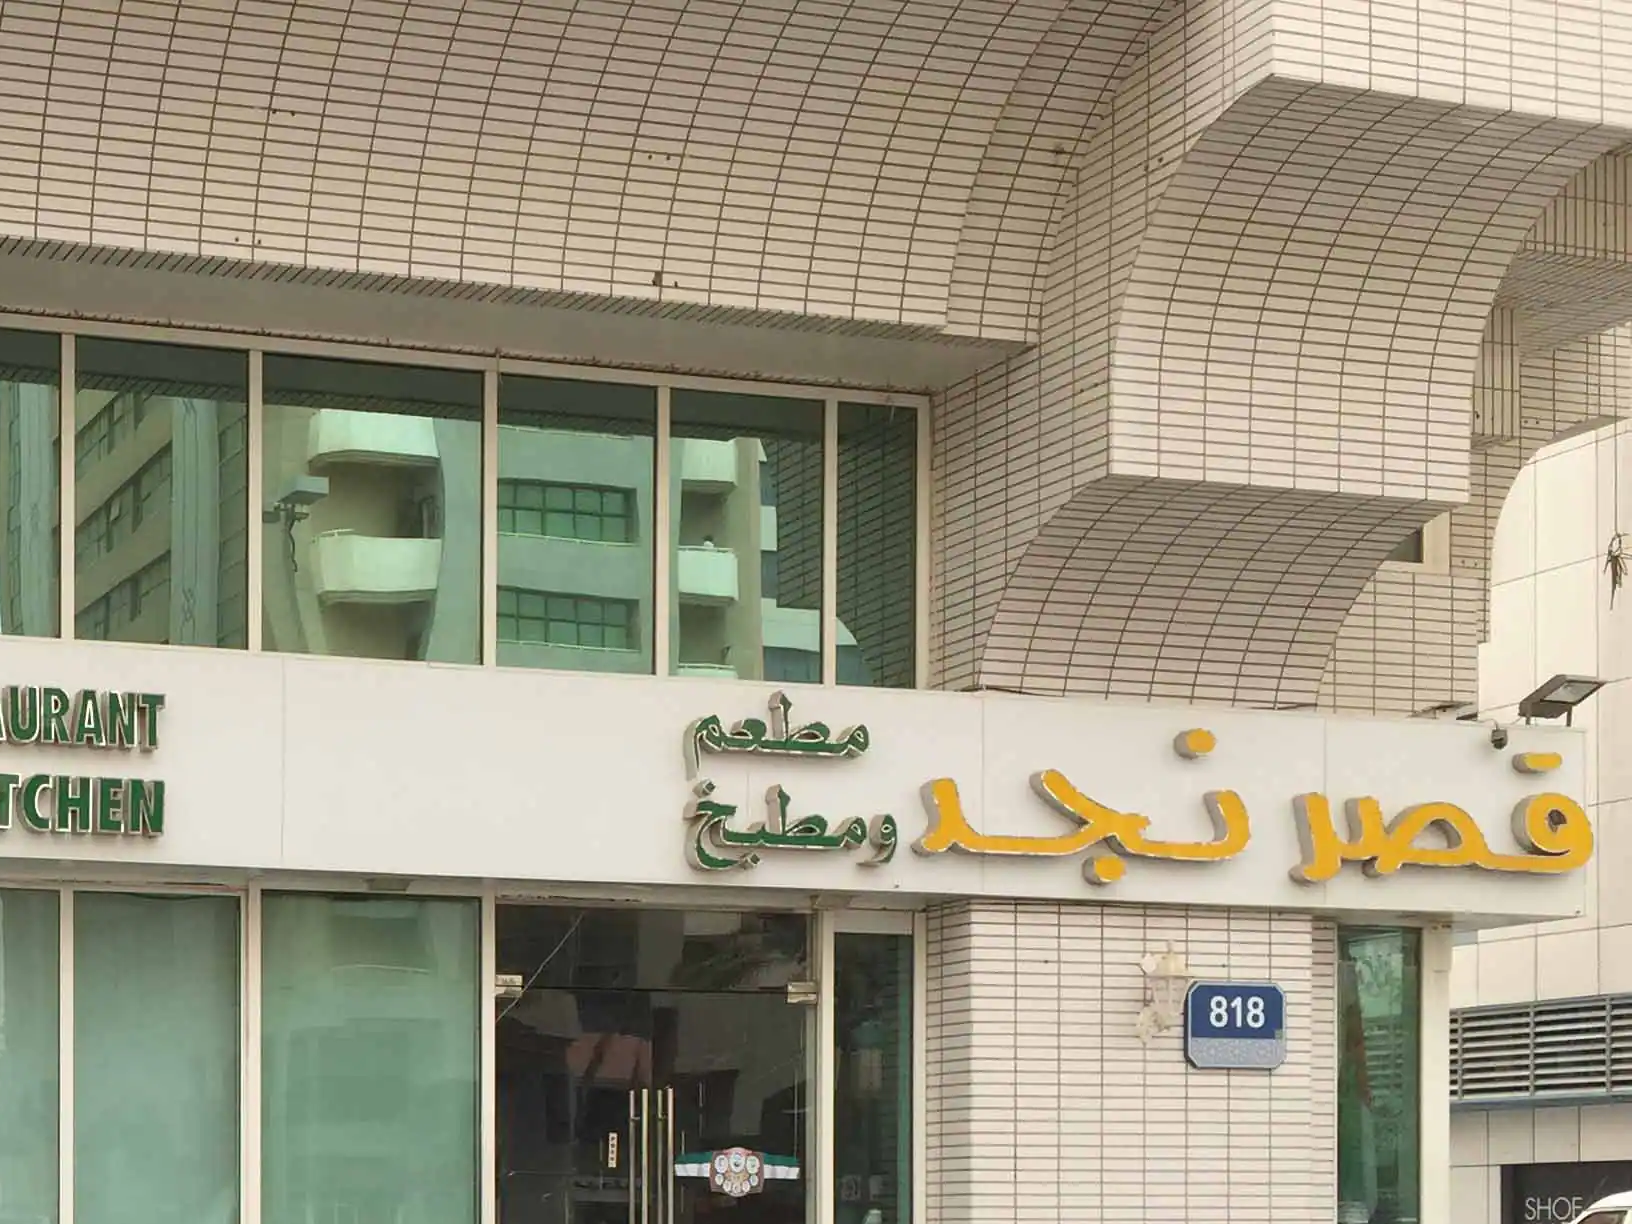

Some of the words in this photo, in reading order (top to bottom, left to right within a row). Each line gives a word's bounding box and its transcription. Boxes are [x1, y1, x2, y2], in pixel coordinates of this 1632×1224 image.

[684, 689, 870, 779] مطعم
[683, 779, 898, 872] ومطبخ
[914, 727, 1251, 886] نجد
[1290, 751, 1594, 885] قصر
[1209, 995, 1265, 1028] 818
[1525, 1197, 1583, 1220] SHOE
